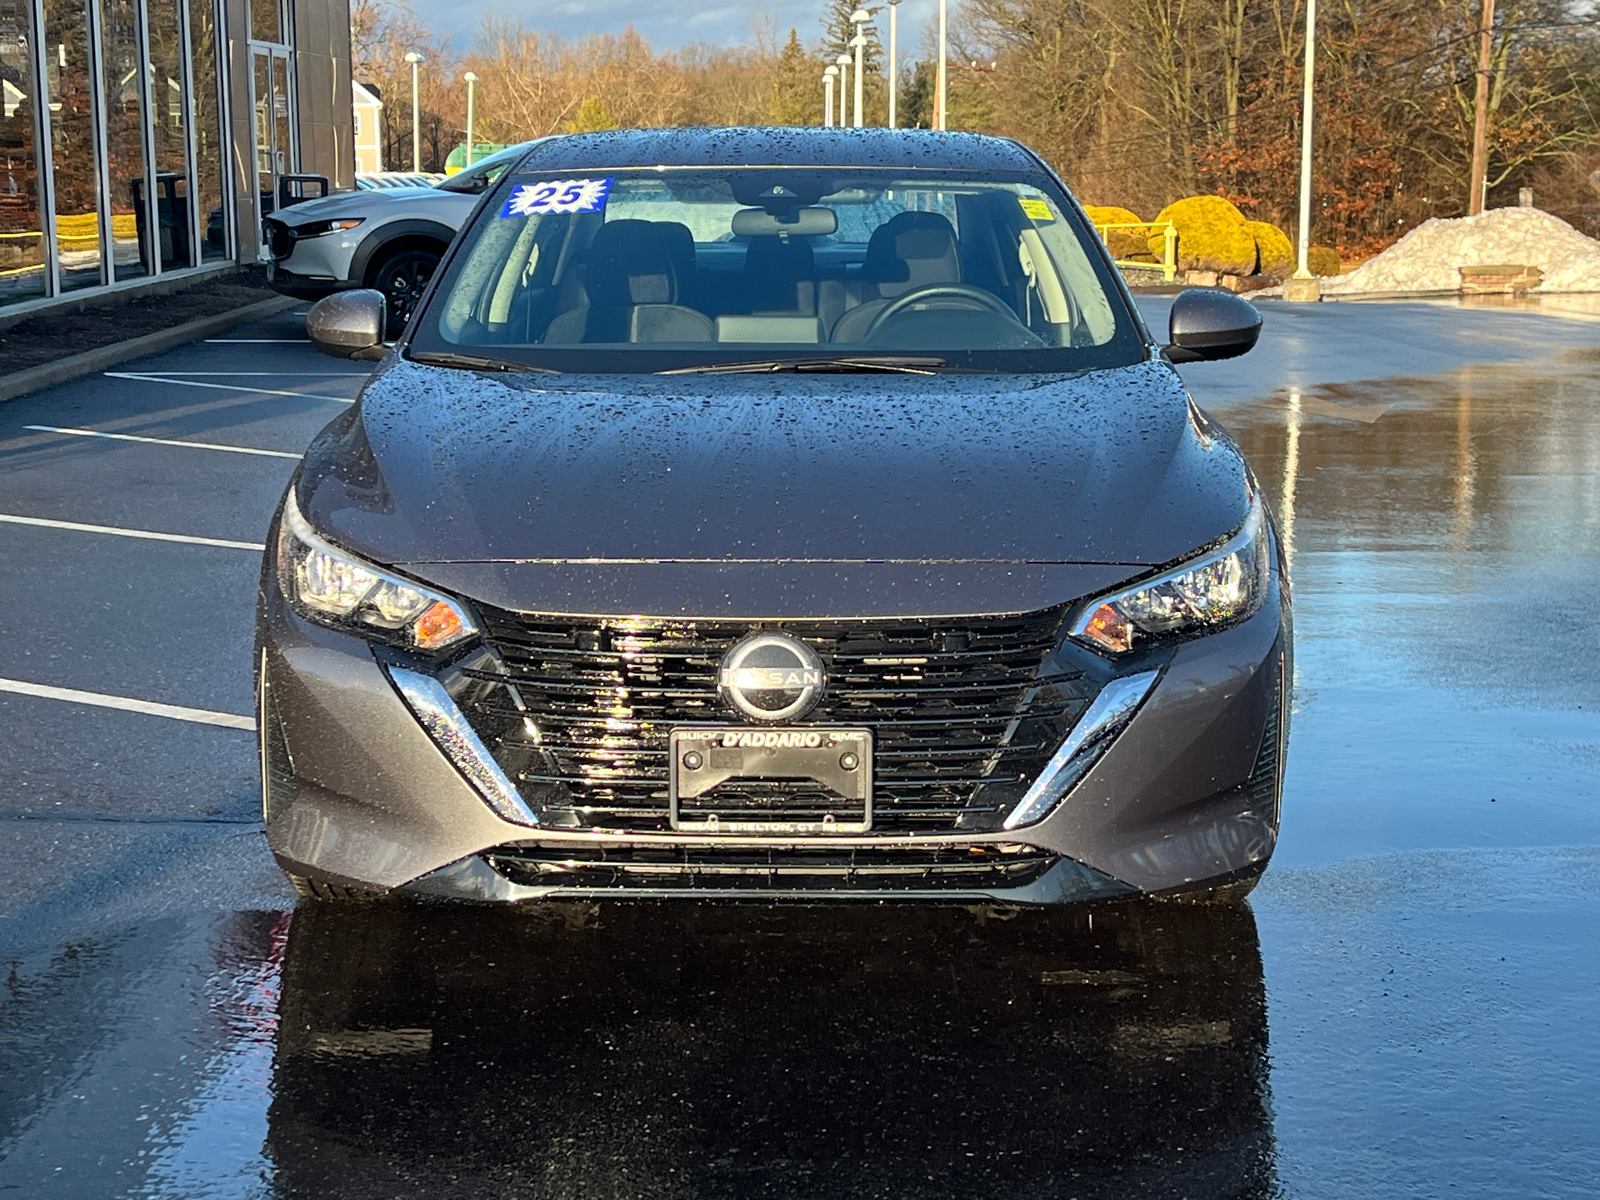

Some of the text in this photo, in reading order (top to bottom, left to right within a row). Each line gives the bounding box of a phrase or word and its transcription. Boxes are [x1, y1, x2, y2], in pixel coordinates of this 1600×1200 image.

[527, 184, 584, 208] 25
[723, 671, 819, 685] NSAN
[678, 732, 864, 748] BUICK D'ADDARIO GMC
[730, 822, 795, 832] SHELTON,
[797, 822, 815, 832] CT
